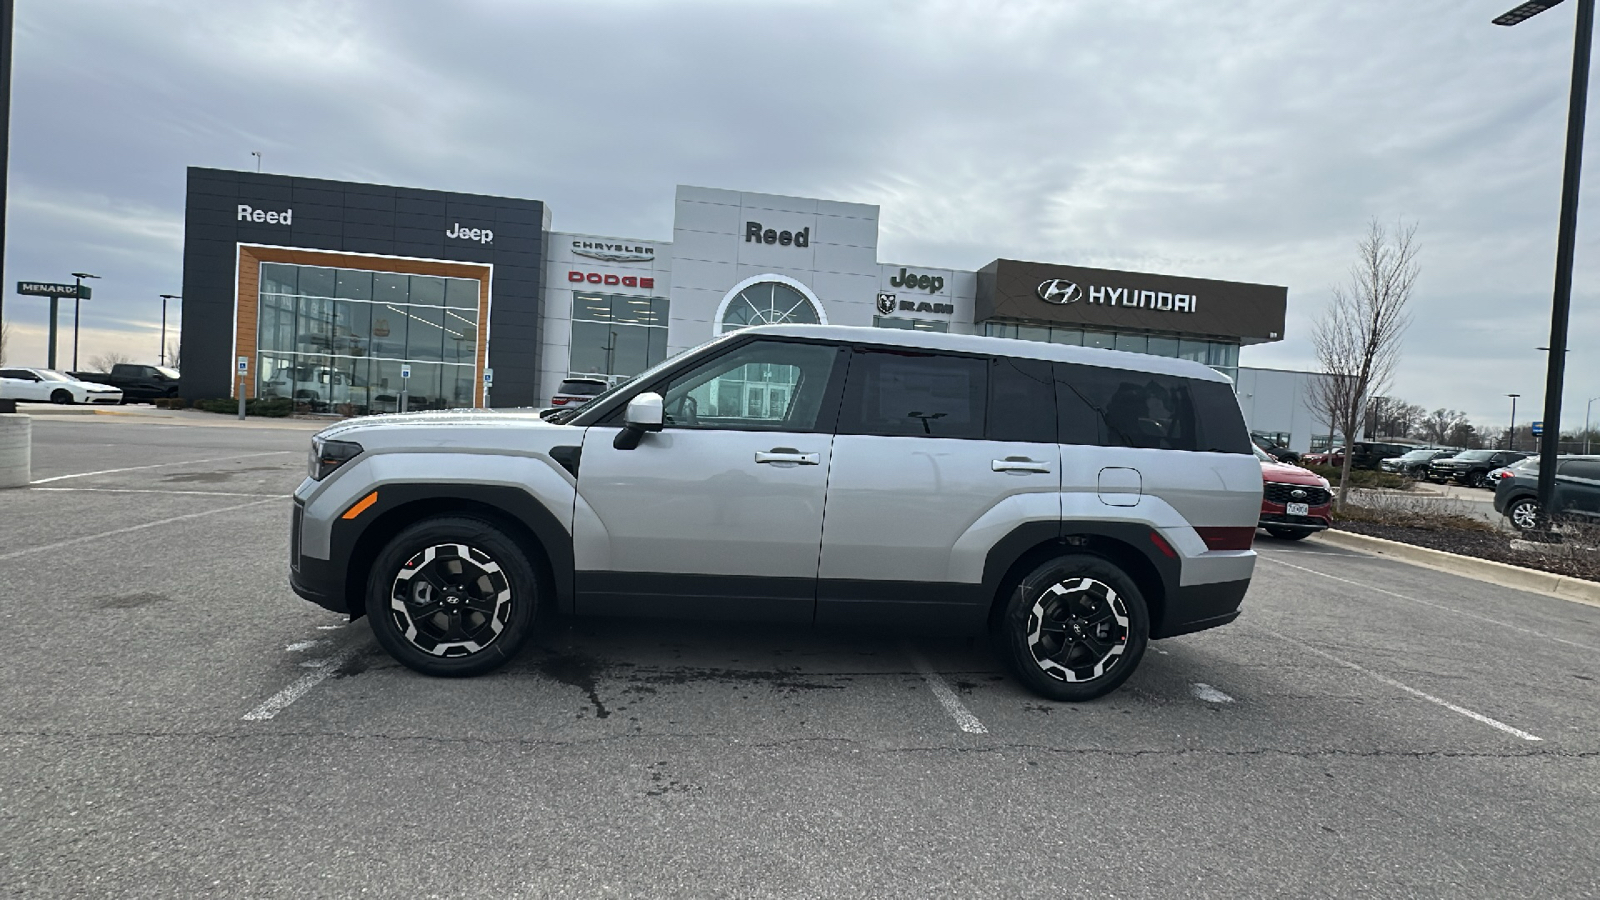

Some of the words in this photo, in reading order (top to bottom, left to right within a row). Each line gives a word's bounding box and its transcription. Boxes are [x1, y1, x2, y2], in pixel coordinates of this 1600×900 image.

[237, 205, 293, 225] Reed
[446, 222, 494, 244] Jeep
[745, 221, 810, 248] Reed
[572, 241, 655, 255] CHRYSLER
[568, 271, 655, 289] DODGE
[890, 268, 944, 294] Jeep
[899, 300, 954, 315] RAM
[1089, 285, 1198, 313] HYUNDAI
